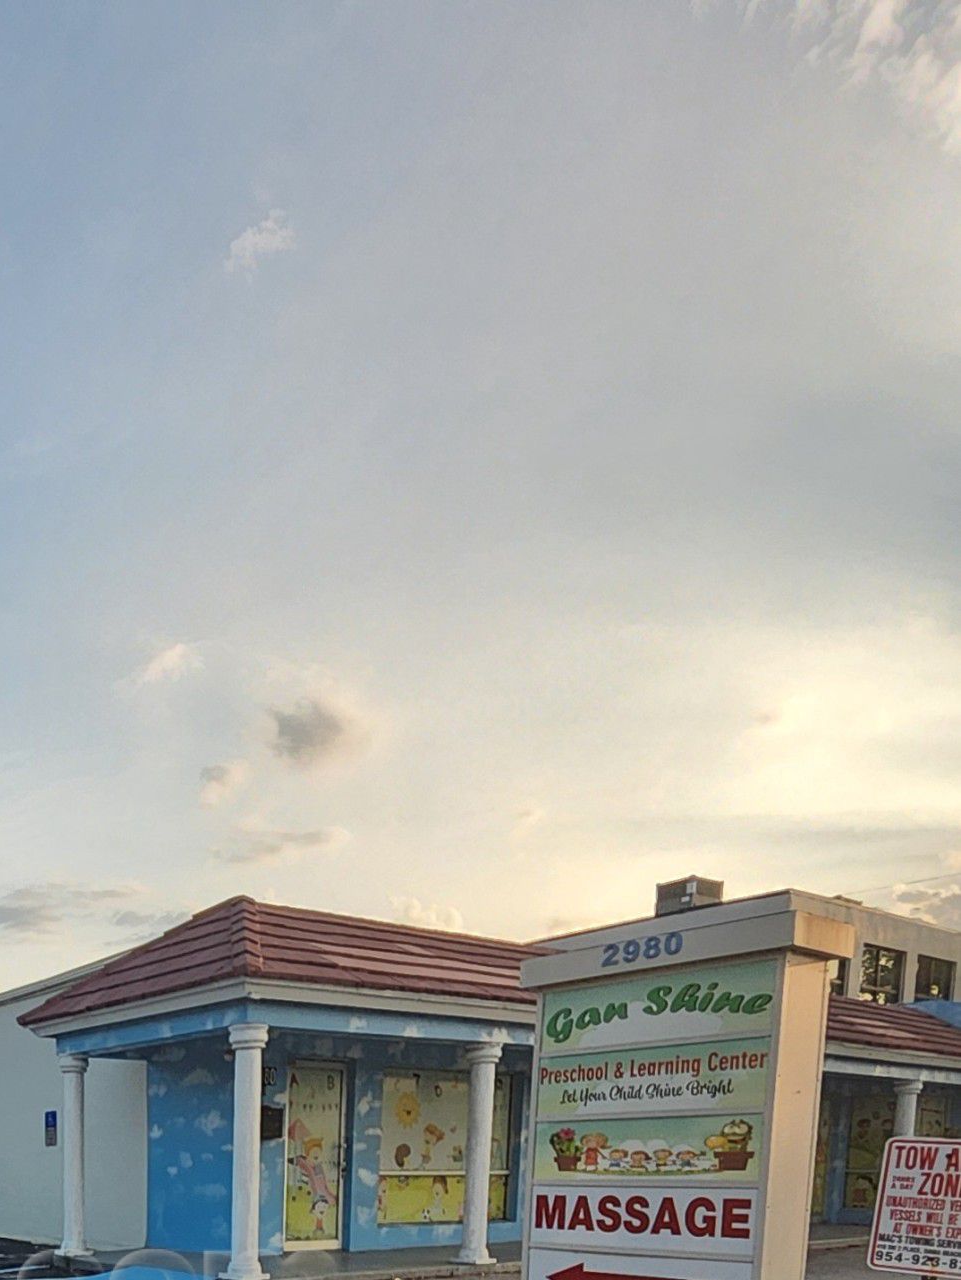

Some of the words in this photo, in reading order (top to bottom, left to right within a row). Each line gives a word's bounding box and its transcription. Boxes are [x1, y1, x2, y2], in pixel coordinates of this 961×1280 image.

[601, 931, 683, 967] 2980
[546, 1001, 629, 1043] Gan
[642, 982, 773, 1015] Shine
[540, 1062, 608, 1085] Preschool
[614, 1062, 624, 1079] &
[630, 1055, 701, 1078] Learning
[708, 1051, 768, 1072] Center
[560, 1089, 578, 1105] Let
[580, 1087, 607, 1106] Your
[609, 1083, 643, 1101] Child
[646, 1081, 683, 1099] Shine
[686, 1078, 734, 1099] Bright
[895, 1145, 939, 1170] TOW
[534, 1194, 752, 1239] MASSAGE
[890, 1209, 922, 1223] VESSELS
[876, 1250, 961, 1269] 954-923-8
